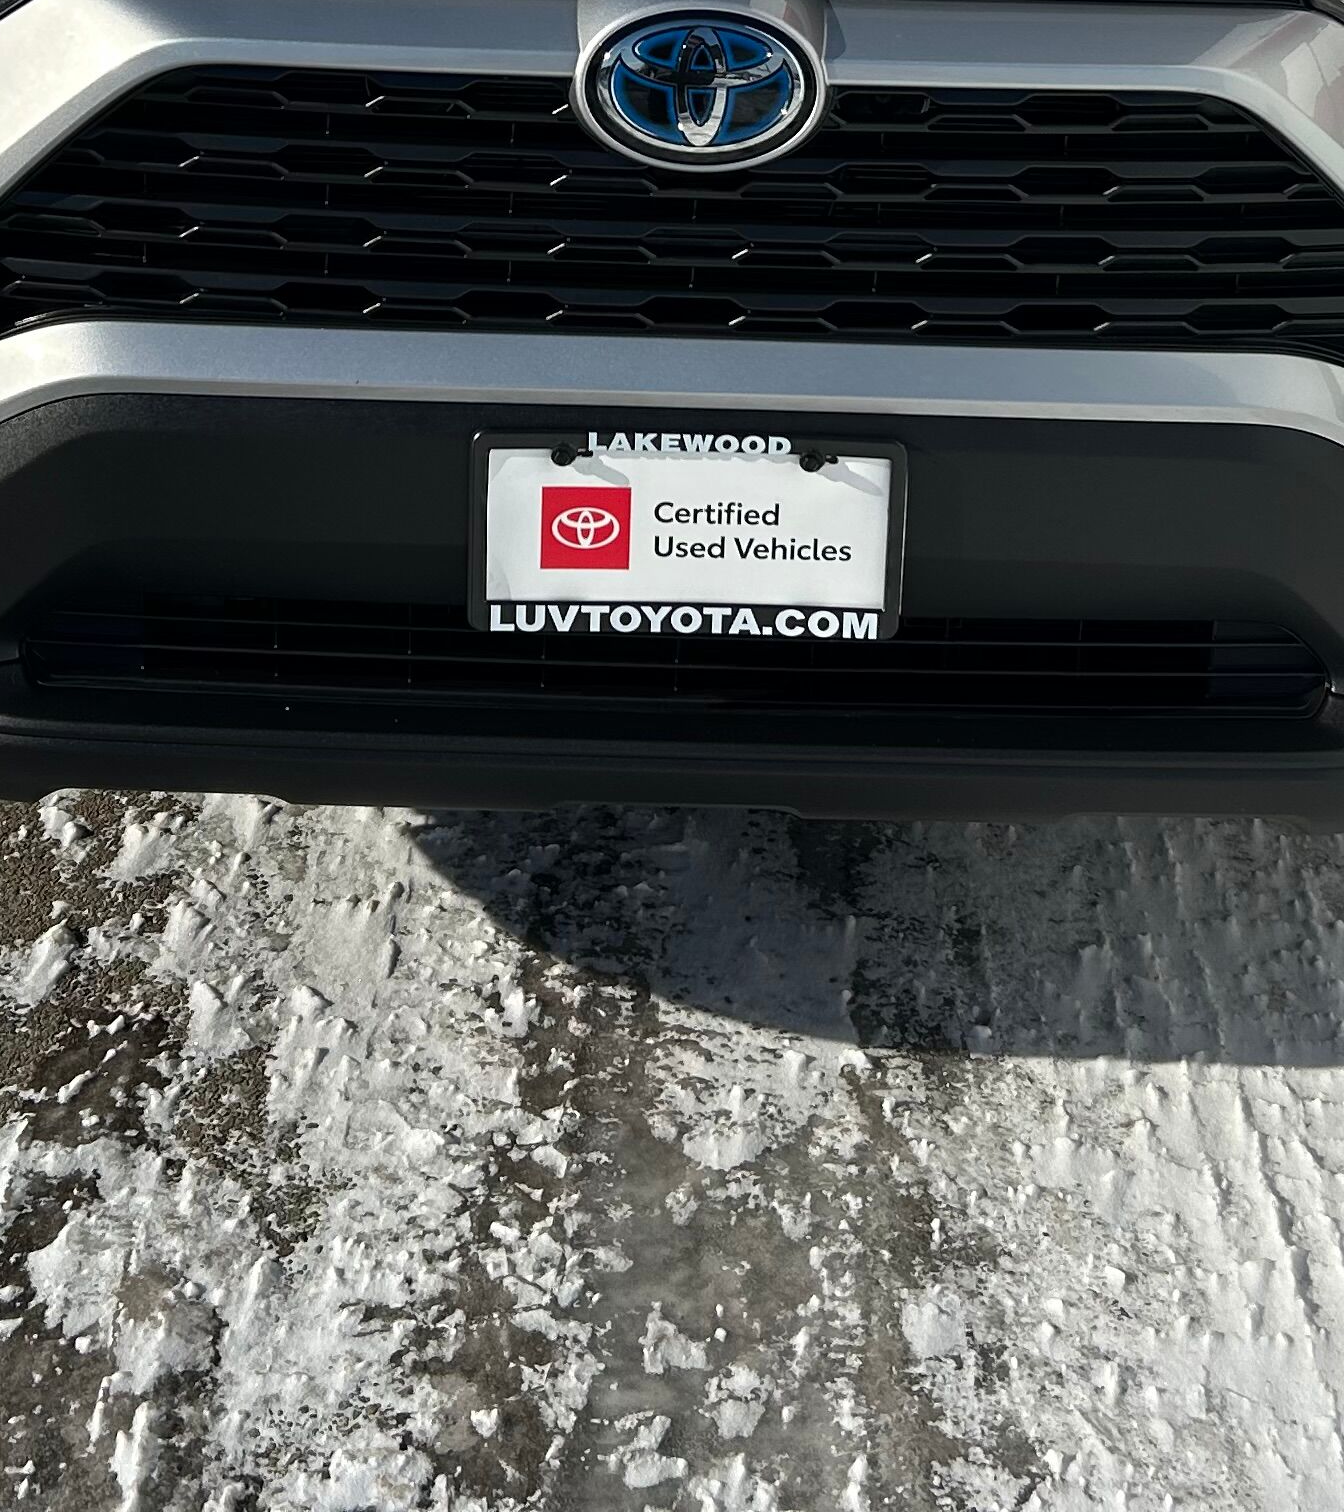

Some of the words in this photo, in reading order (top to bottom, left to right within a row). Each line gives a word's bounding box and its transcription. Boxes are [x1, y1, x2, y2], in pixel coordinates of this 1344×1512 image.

[588, 432, 792, 455] LAKEWOOD
[654, 501, 780, 527] Certified
[654, 535, 725, 560] Used
[734, 537, 852, 562] Vehicles
[490, 604, 879, 640] LUVTOYOTA.COM
